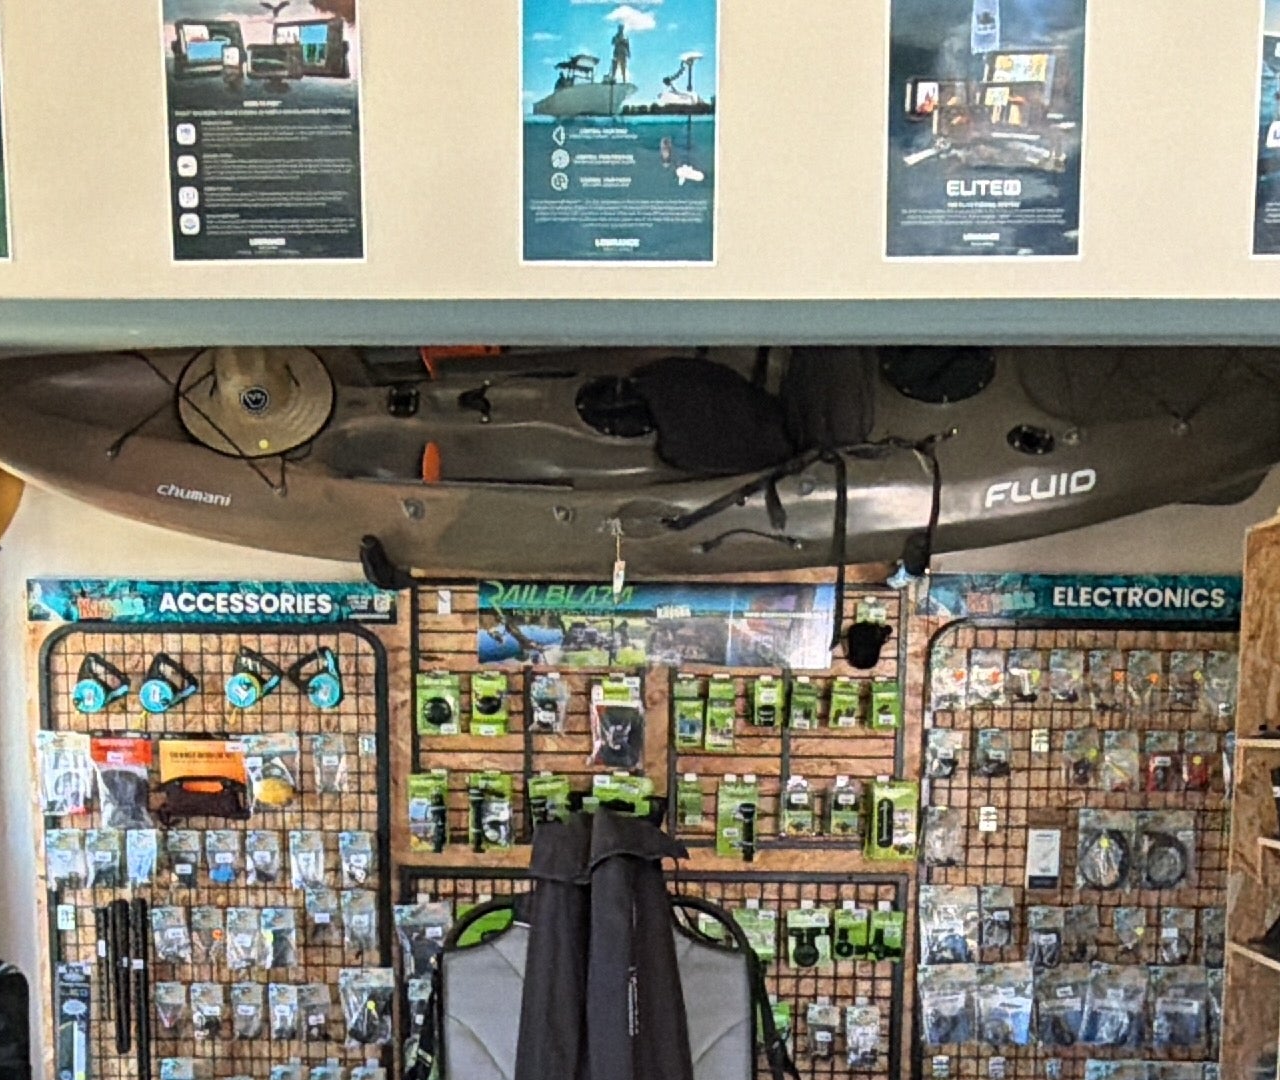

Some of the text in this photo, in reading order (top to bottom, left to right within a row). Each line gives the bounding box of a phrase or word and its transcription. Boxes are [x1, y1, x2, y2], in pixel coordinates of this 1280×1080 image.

[156, 482, 232, 508] chumani
[984, 468, 1097, 509] FLUID
[158, 592, 332, 614] ACCESSORIES
[1052, 586, 1227, 609] ELECTRONICS
